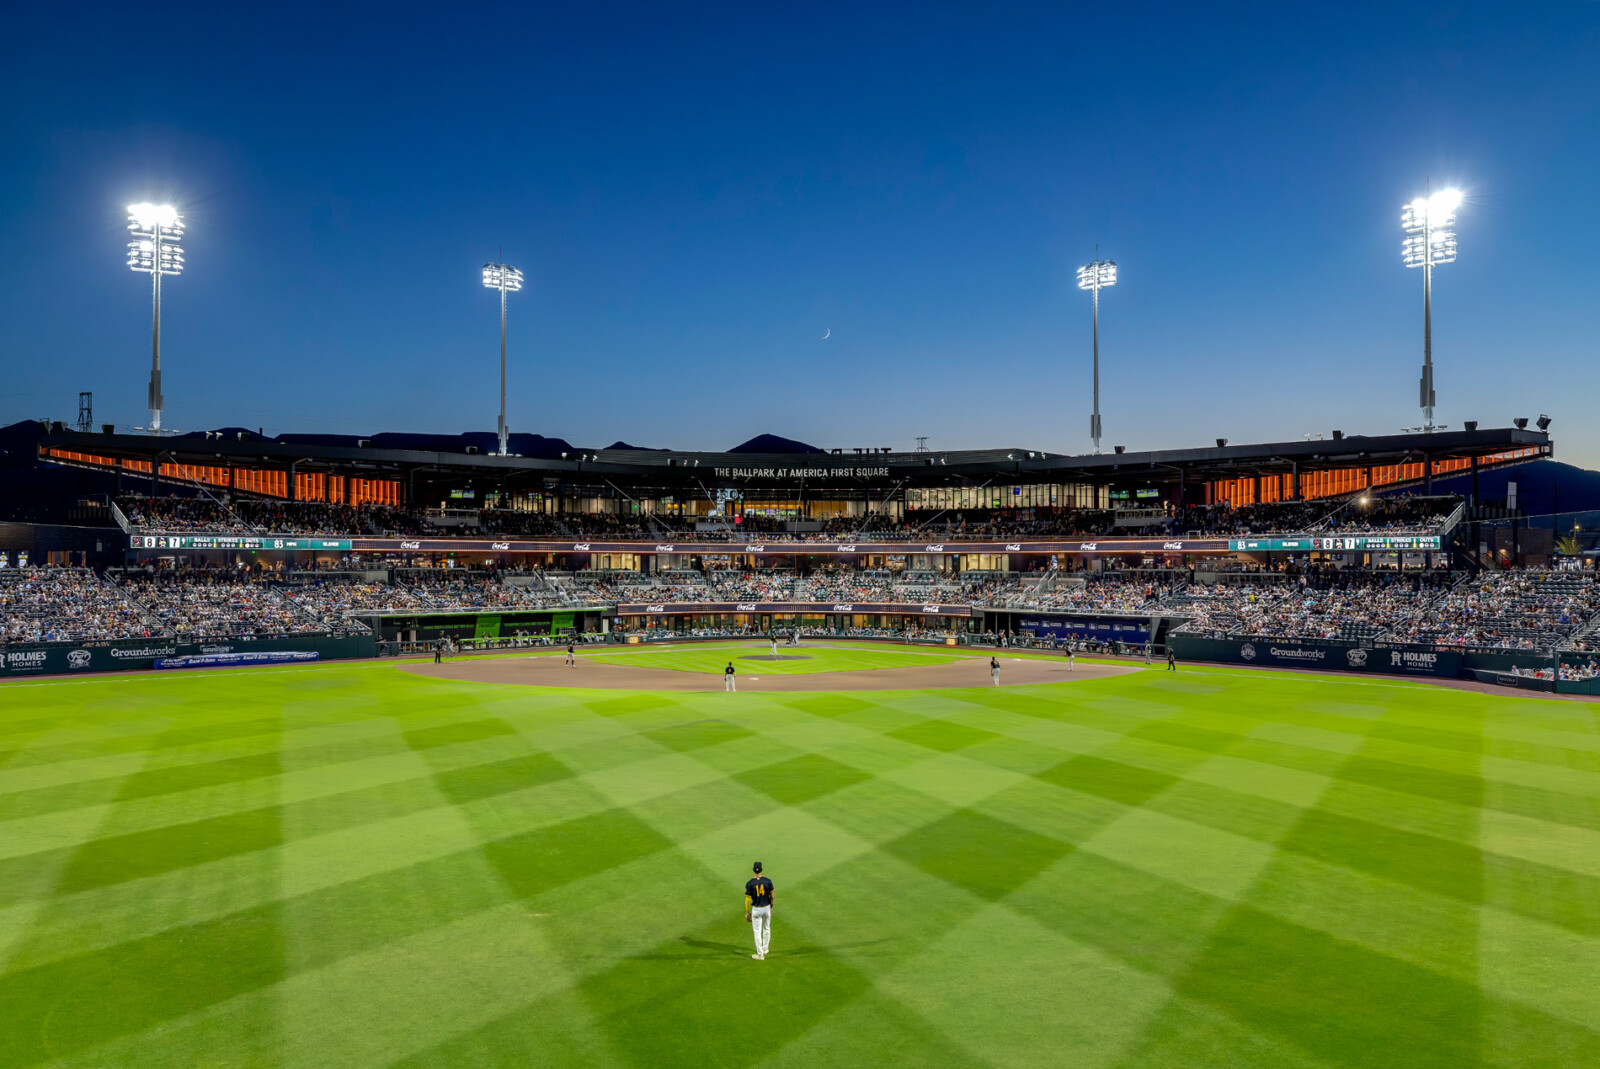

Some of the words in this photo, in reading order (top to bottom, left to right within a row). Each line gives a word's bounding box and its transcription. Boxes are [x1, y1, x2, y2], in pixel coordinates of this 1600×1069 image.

[714, 467, 730, 477] THE
[732, 468, 775, 477] BALLPARK
[777, 468, 788, 477] AT
[789, 468, 829, 477] AMERICA
[830, 468, 853, 477] FIRST
[856, 467, 889, 476] SQUARE
[274, 539, 284, 548] 83
[7, 652, 47, 662] HOLMES
[110, 646, 176, 657] Groundworks
[1270, 647, 1325, 659] Groundworks
[1403, 652, 1437, 663] HOLMES
[755, 884, 765, 897] 14
